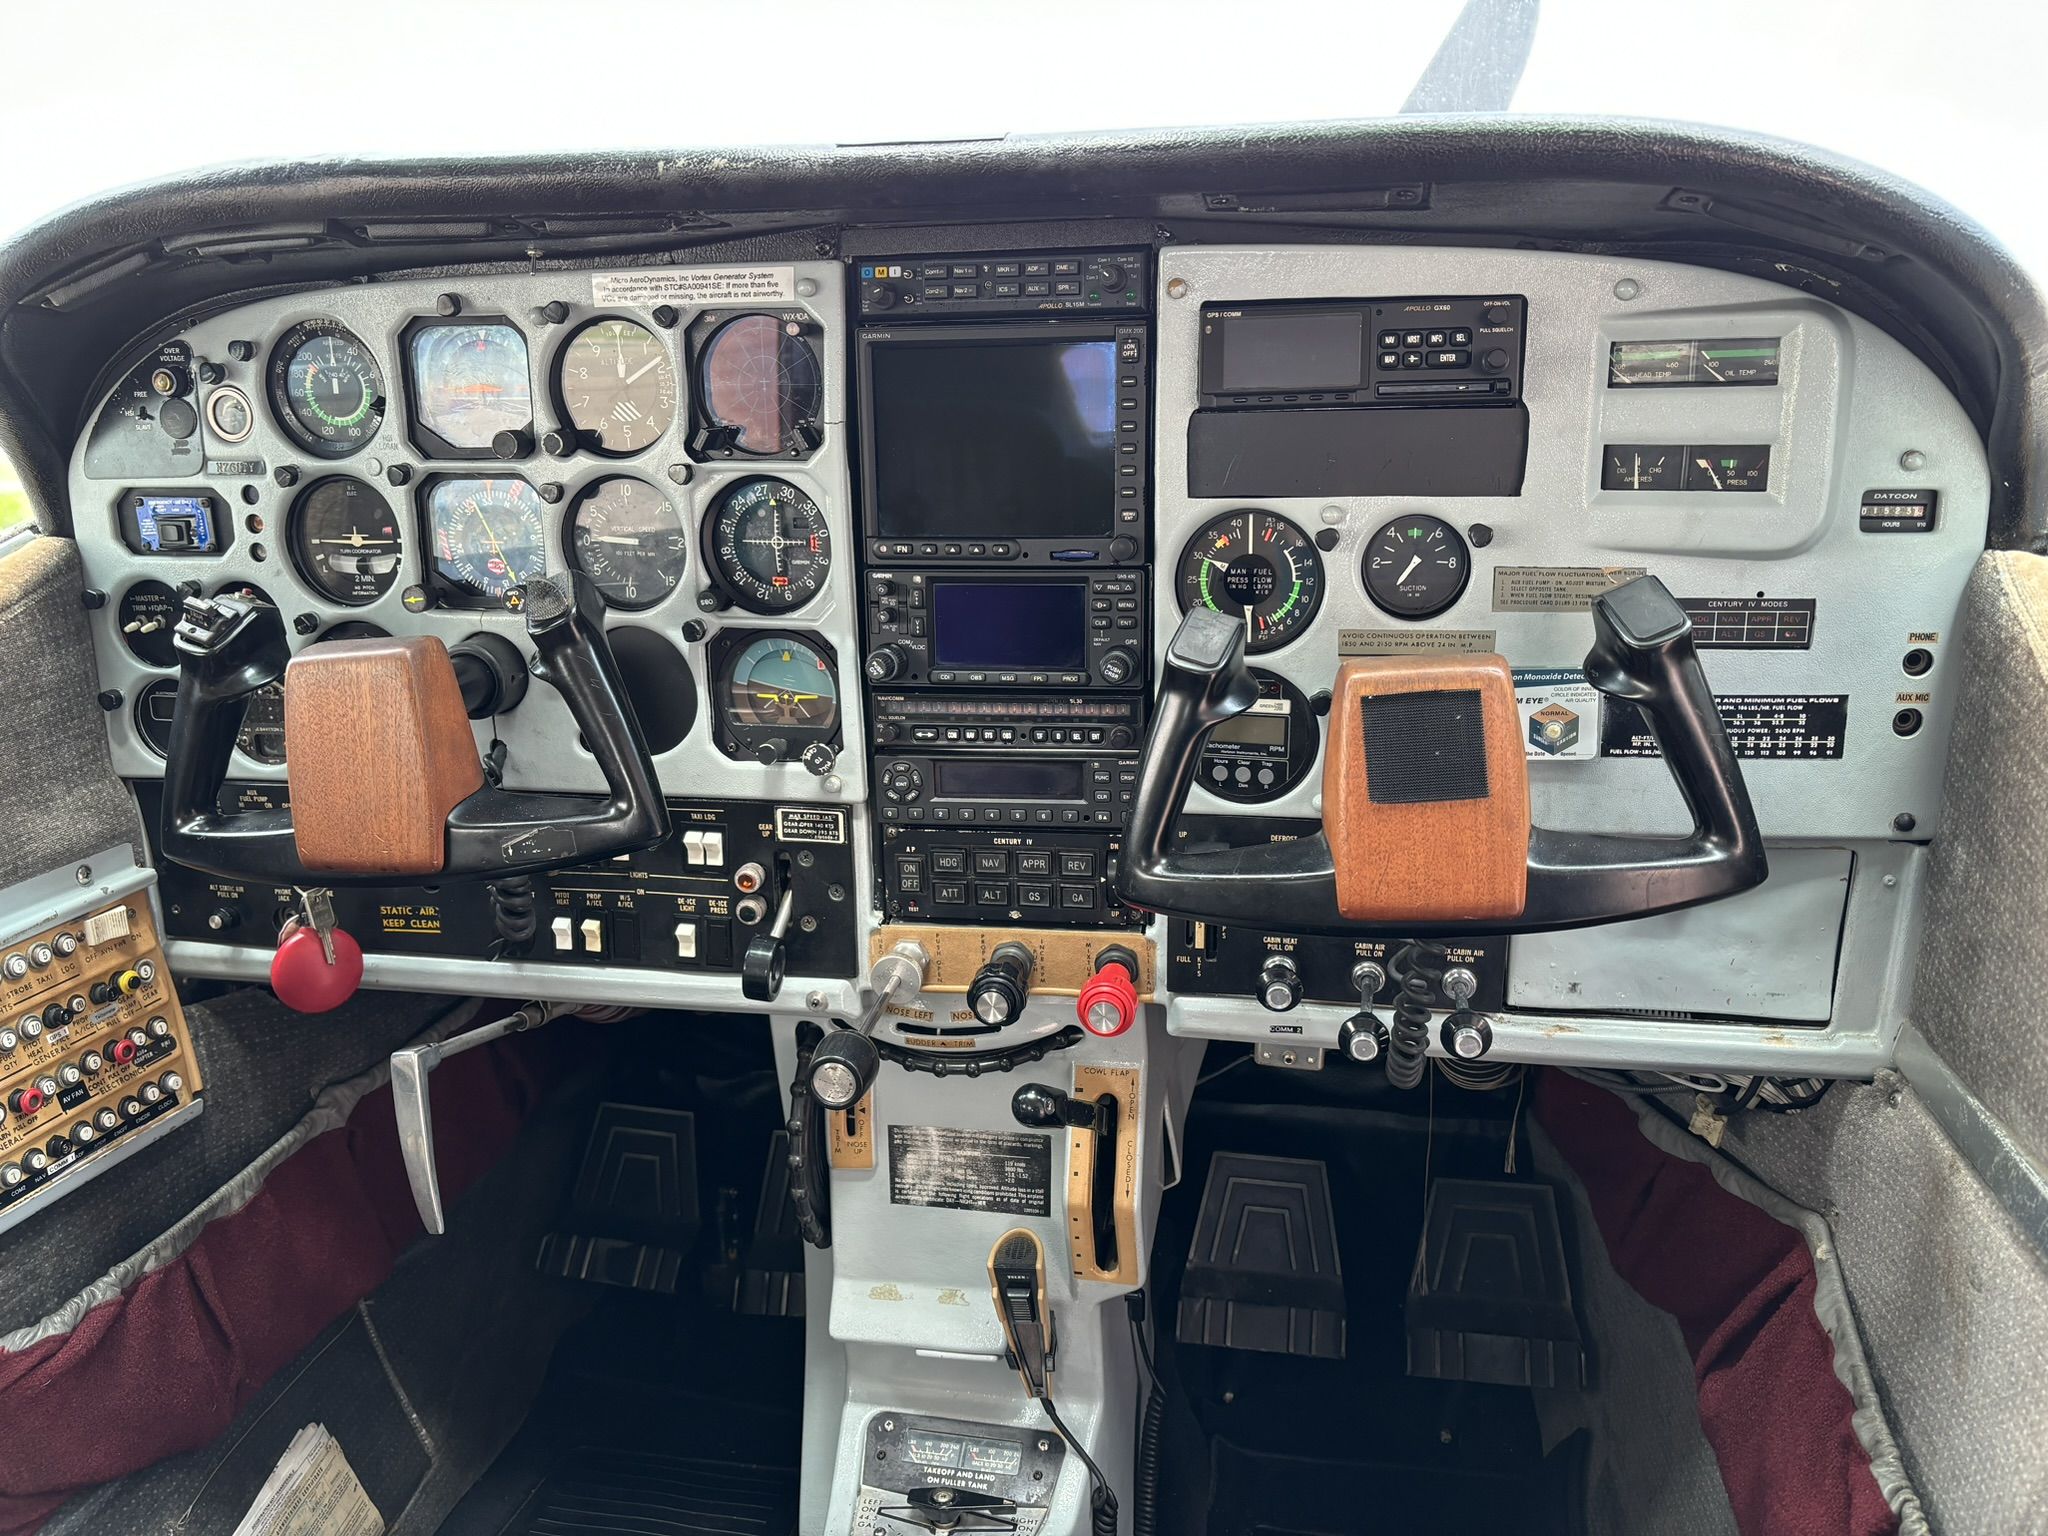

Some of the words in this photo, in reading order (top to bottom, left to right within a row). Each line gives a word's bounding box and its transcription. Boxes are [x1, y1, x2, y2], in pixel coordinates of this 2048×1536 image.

[1407, 335, 1420, 343] NRST
[1431, 335, 1442, 343] INFO
[1456, 334, 1465, 342] SEL
[592, 343, 600, 355] 9
[1384, 355, 1395, 364] MAP
[1440, 353, 1456, 362] ENTER
[579, 367, 588, 378] 8
[660, 397, 668, 408] 3
[623, 426, 632, 437] 5
[755, 485, 767, 498] 27
[781, 486, 794, 498] 30
[1897, 693, 1914, 701] AUX
[1915, 693, 1929, 701] MIC
[940, 858, 957, 867] HDG
[982, 859, 999, 867] NAV
[1023, 859, 1046, 869] APPR
[1068, 861, 1085, 870] REV
[904, 864, 915, 872] ON
[902, 880, 918, 888] OFF
[942, 889, 958, 897] ATT
[984, 891, 1000, 899] ALT
[1029, 892, 1040, 901] GS
[1072, 893, 1083, 902] GA
[381, 906, 413, 916] STATIC
[383, 919, 405, 928] KEEP
[410, 919, 440, 929] CLEAN
[1283, 937, 1298, 945] HEAT
[61, 963, 75, 974] LDG
[36, 974, 53, 984] TAXI
[6, 982, 33, 999] STROBE
[886, 1006, 912, 1016] NOSE
[914, 1010, 934, 1019] LEFT
[33, 1044, 71, 1066] GENERAL
[1084, 1067, 1108, 1076] COWL
[100, 1066, 146, 1095] ELECTRONICS
[63, 1094, 71, 1104] AV
[72, 1089, 84, 1098] FAN
[924, 1466, 955, 1476] TAKEOFF
[956, 1470, 973, 1479] AND
[975, 1473, 995, 1482] LAND
[927, 1476, 940, 1484] ON
[941, 1478, 966, 1487] FULLER
[968, 1482, 988, 1490] TANK
